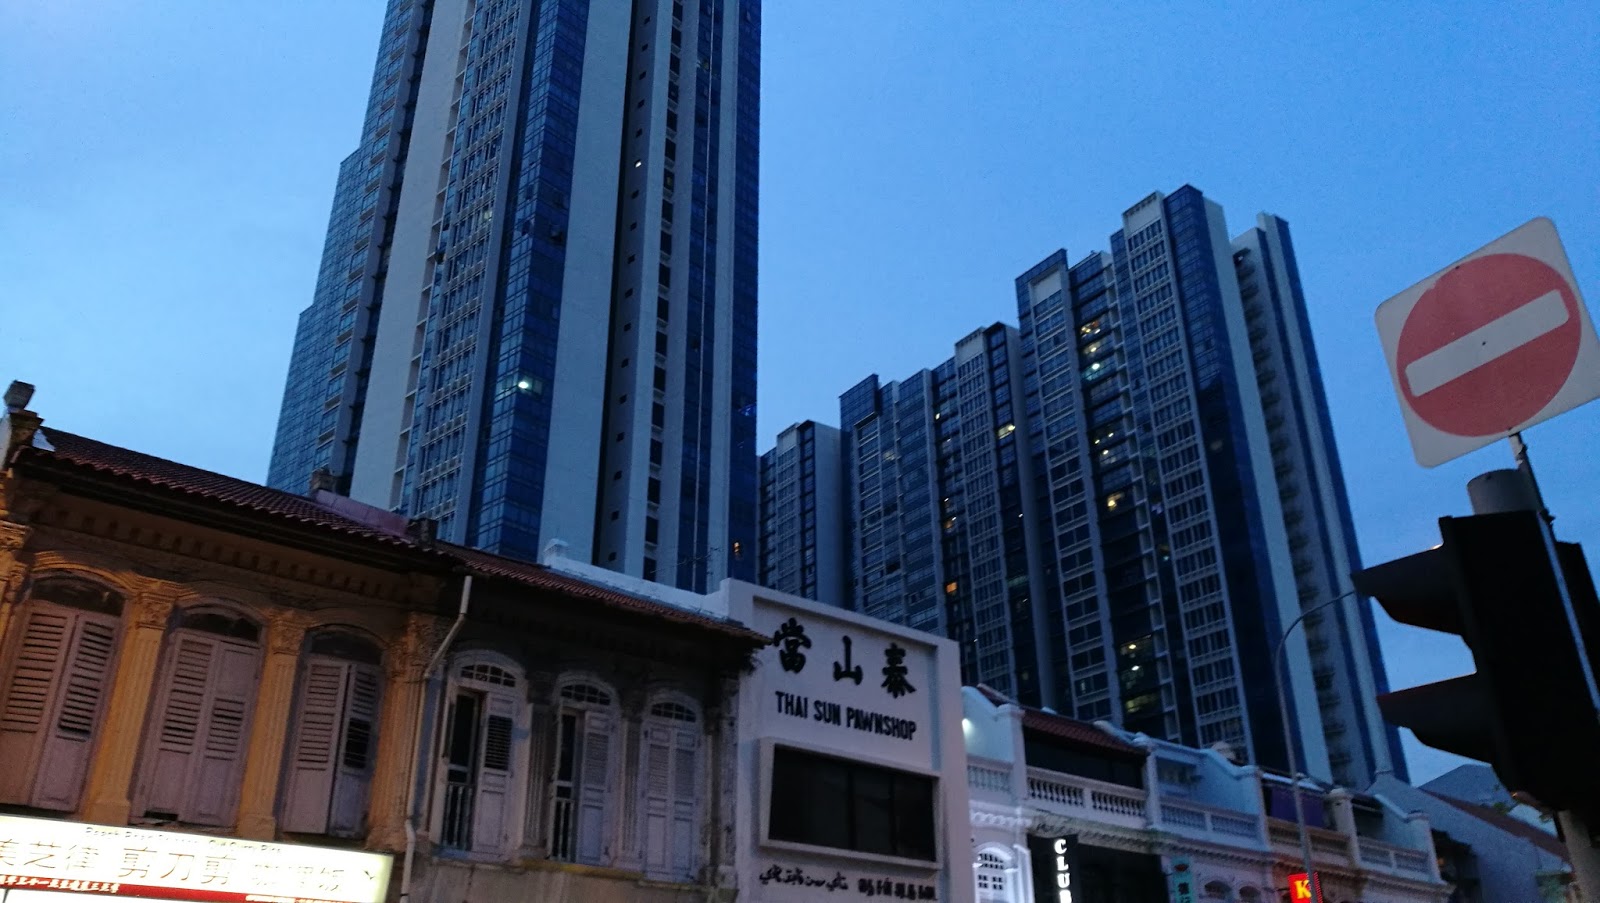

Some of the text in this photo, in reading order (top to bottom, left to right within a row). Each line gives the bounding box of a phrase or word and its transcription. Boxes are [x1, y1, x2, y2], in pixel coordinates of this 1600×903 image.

[775, 691, 916, 740] THAI SUN PAWNSHOP
